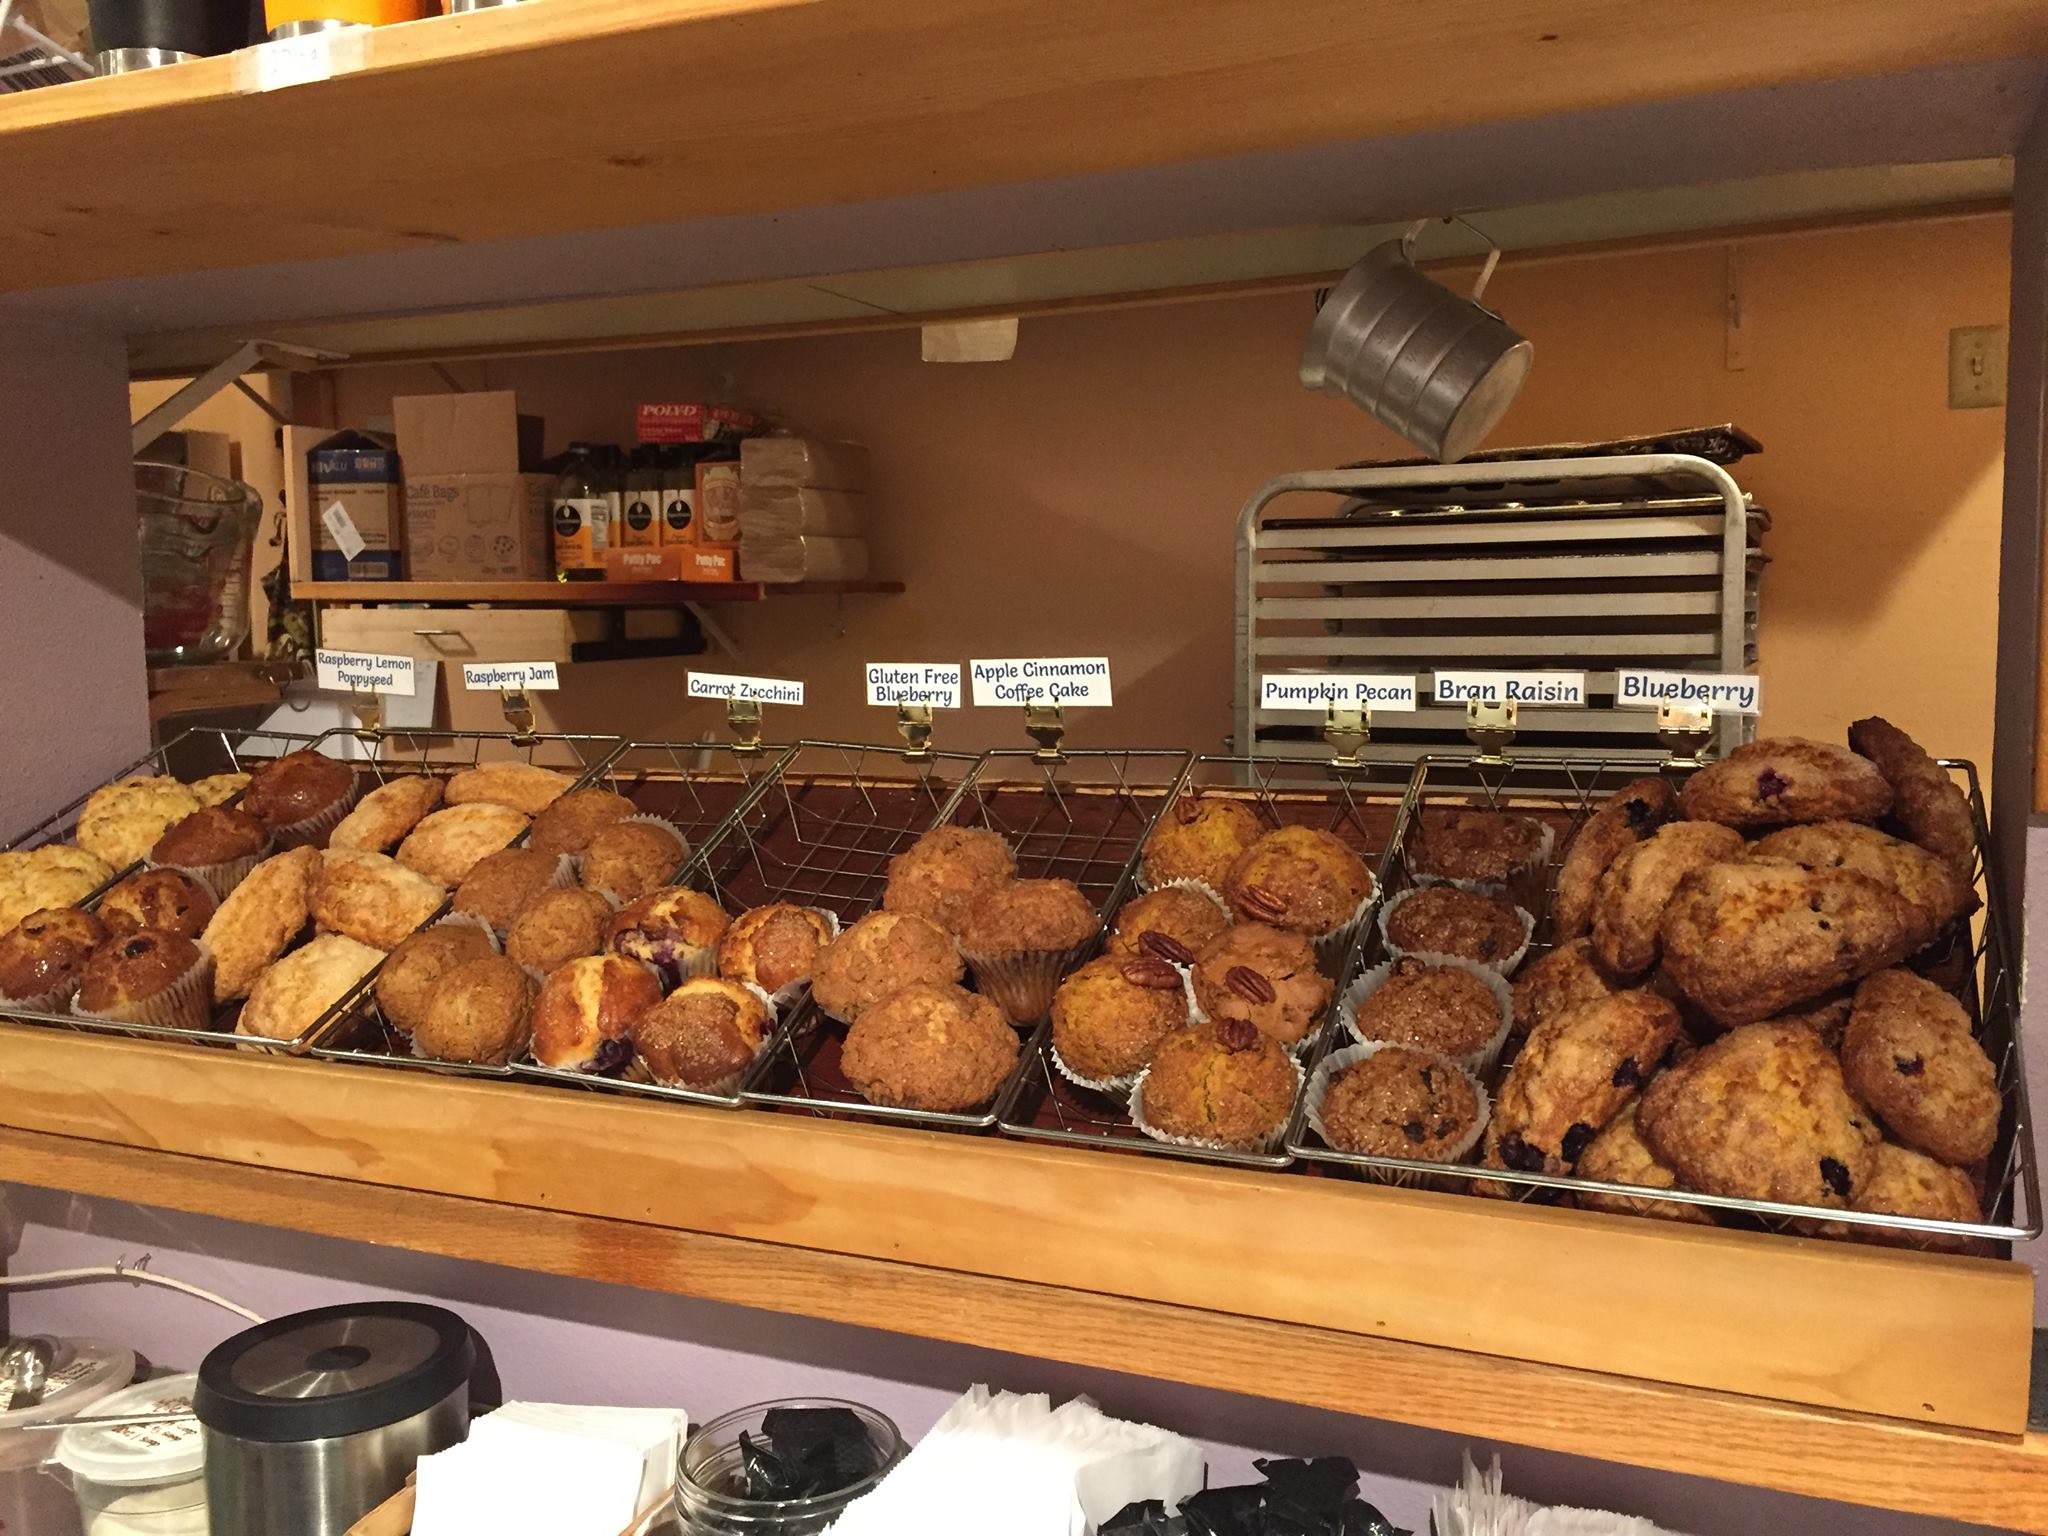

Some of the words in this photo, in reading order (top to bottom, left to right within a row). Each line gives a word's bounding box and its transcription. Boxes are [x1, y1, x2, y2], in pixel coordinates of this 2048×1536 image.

[433, 485, 460, 502] Bags
[318, 652, 373, 671] Raspberry
[375, 656, 412, 670] Lemon
[337, 670, 394, 687] Poppyseed
[465, 671, 526, 686] Raspberry
[528, 667, 555, 682] Jam
[868, 668, 919, 684] Gluten
[924, 668, 959, 684] Free
[974, 663, 1019, 683] Apple
[1022, 662, 1106, 678] Cinnamon
[690, 679, 736, 696] Carrot
[740, 683, 801, 702] Zucchini
[875, 686, 953, 706] Blueberry
[995, 683, 1044, 702] Coffee
[1049, 681, 1089, 698] Cake
[1265, 682, 1349, 703] Pumpkin
[1355, 684, 1413, 701] Pecan
[1438, 679, 1496, 699] Bran
[1505, 680, 1578, 701] Raisin
[1623, 675, 1755, 709] Blueberry
